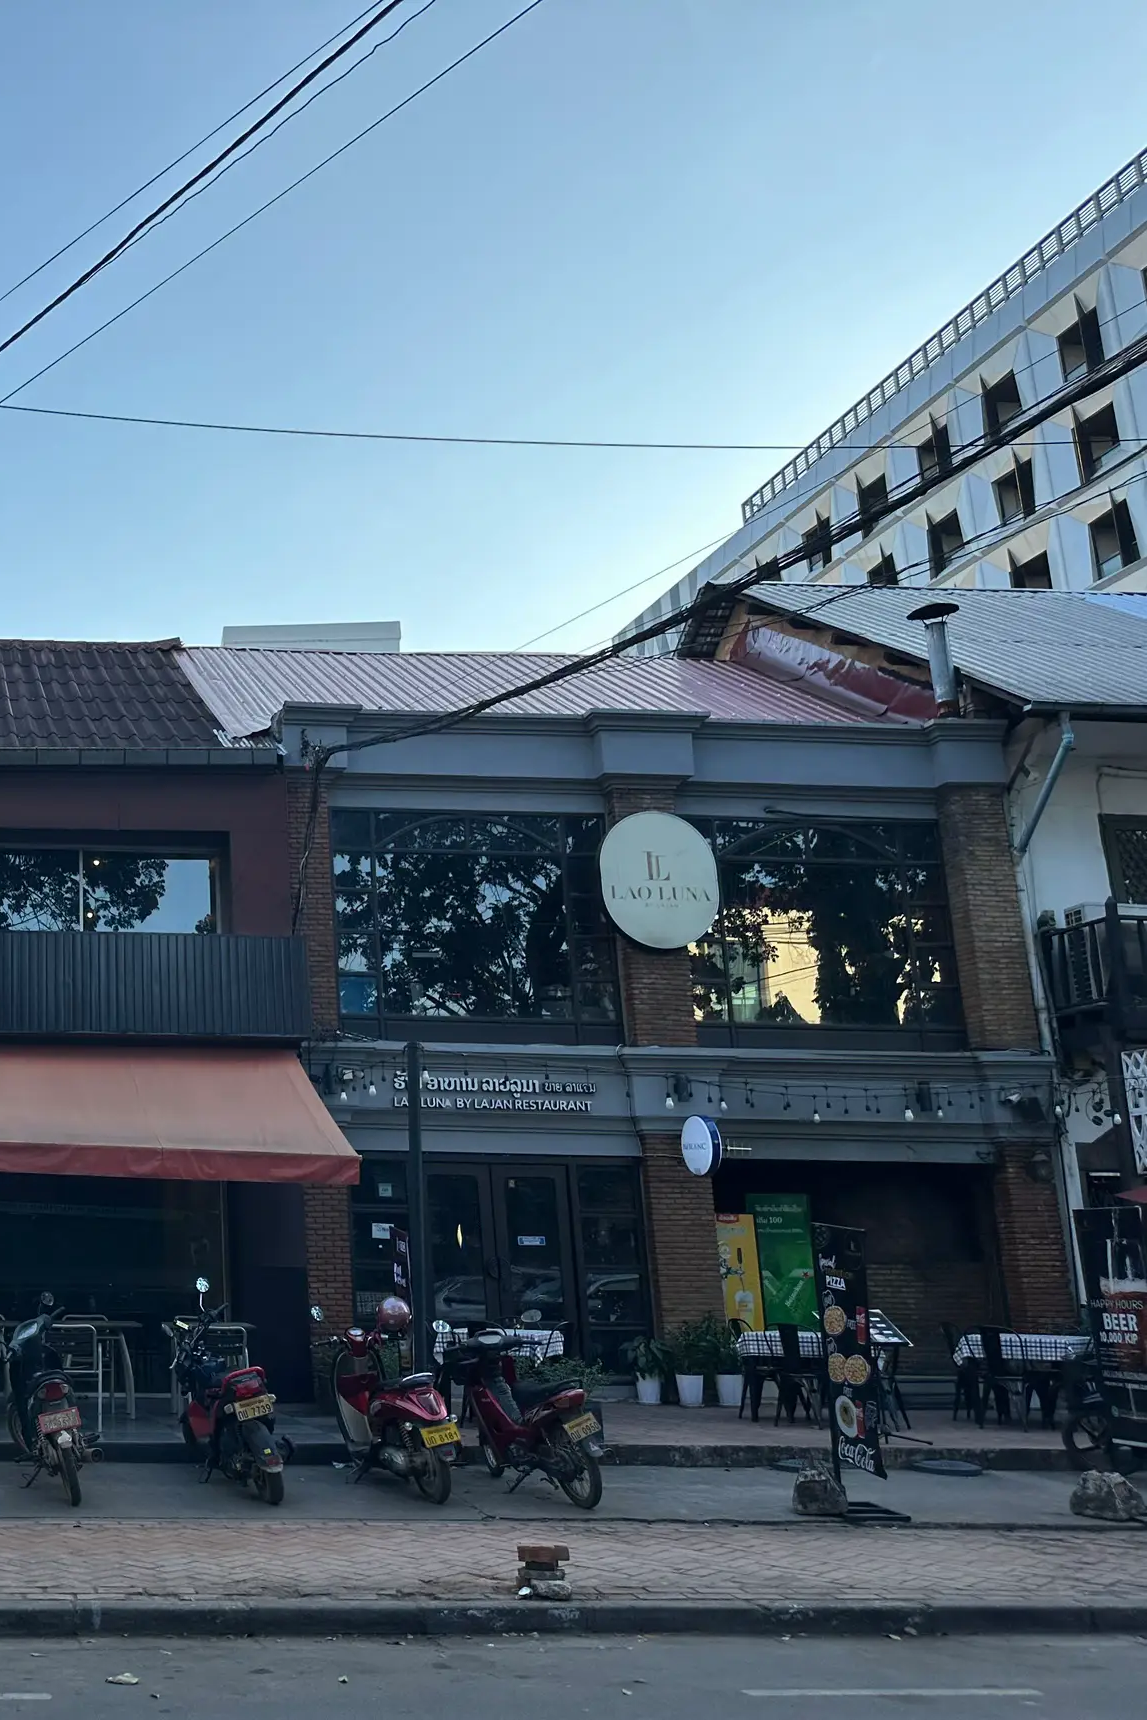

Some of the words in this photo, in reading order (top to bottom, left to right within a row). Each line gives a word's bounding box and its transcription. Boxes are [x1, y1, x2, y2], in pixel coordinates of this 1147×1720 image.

[610, 885, 652, 900] LAO
[658, 886, 713, 902] LUNA
[420, 1096, 453, 1109] LUNA
[456, 1097, 472, 1109] BY
[474, 1098, 512, 1110] LAJAN
[514, 1099, 593, 1112] RESTAURANT
[825, 1275, 846, 1289] PIZZA
[1089, 1299, 1115, 1310] HAPPY
[1115, 1300, 1144, 1310] HOURS
[1102, 1312, 1139, 1332] BEER
[1099, 1331, 1123, 1344] 10,000
[1124, 1332, 1139, 1345] KIP
[250, 1403, 272, 1416] 7739
[581, 1421, 600, 1435] 0950
[438, 1431, 459, 1442] 8181
